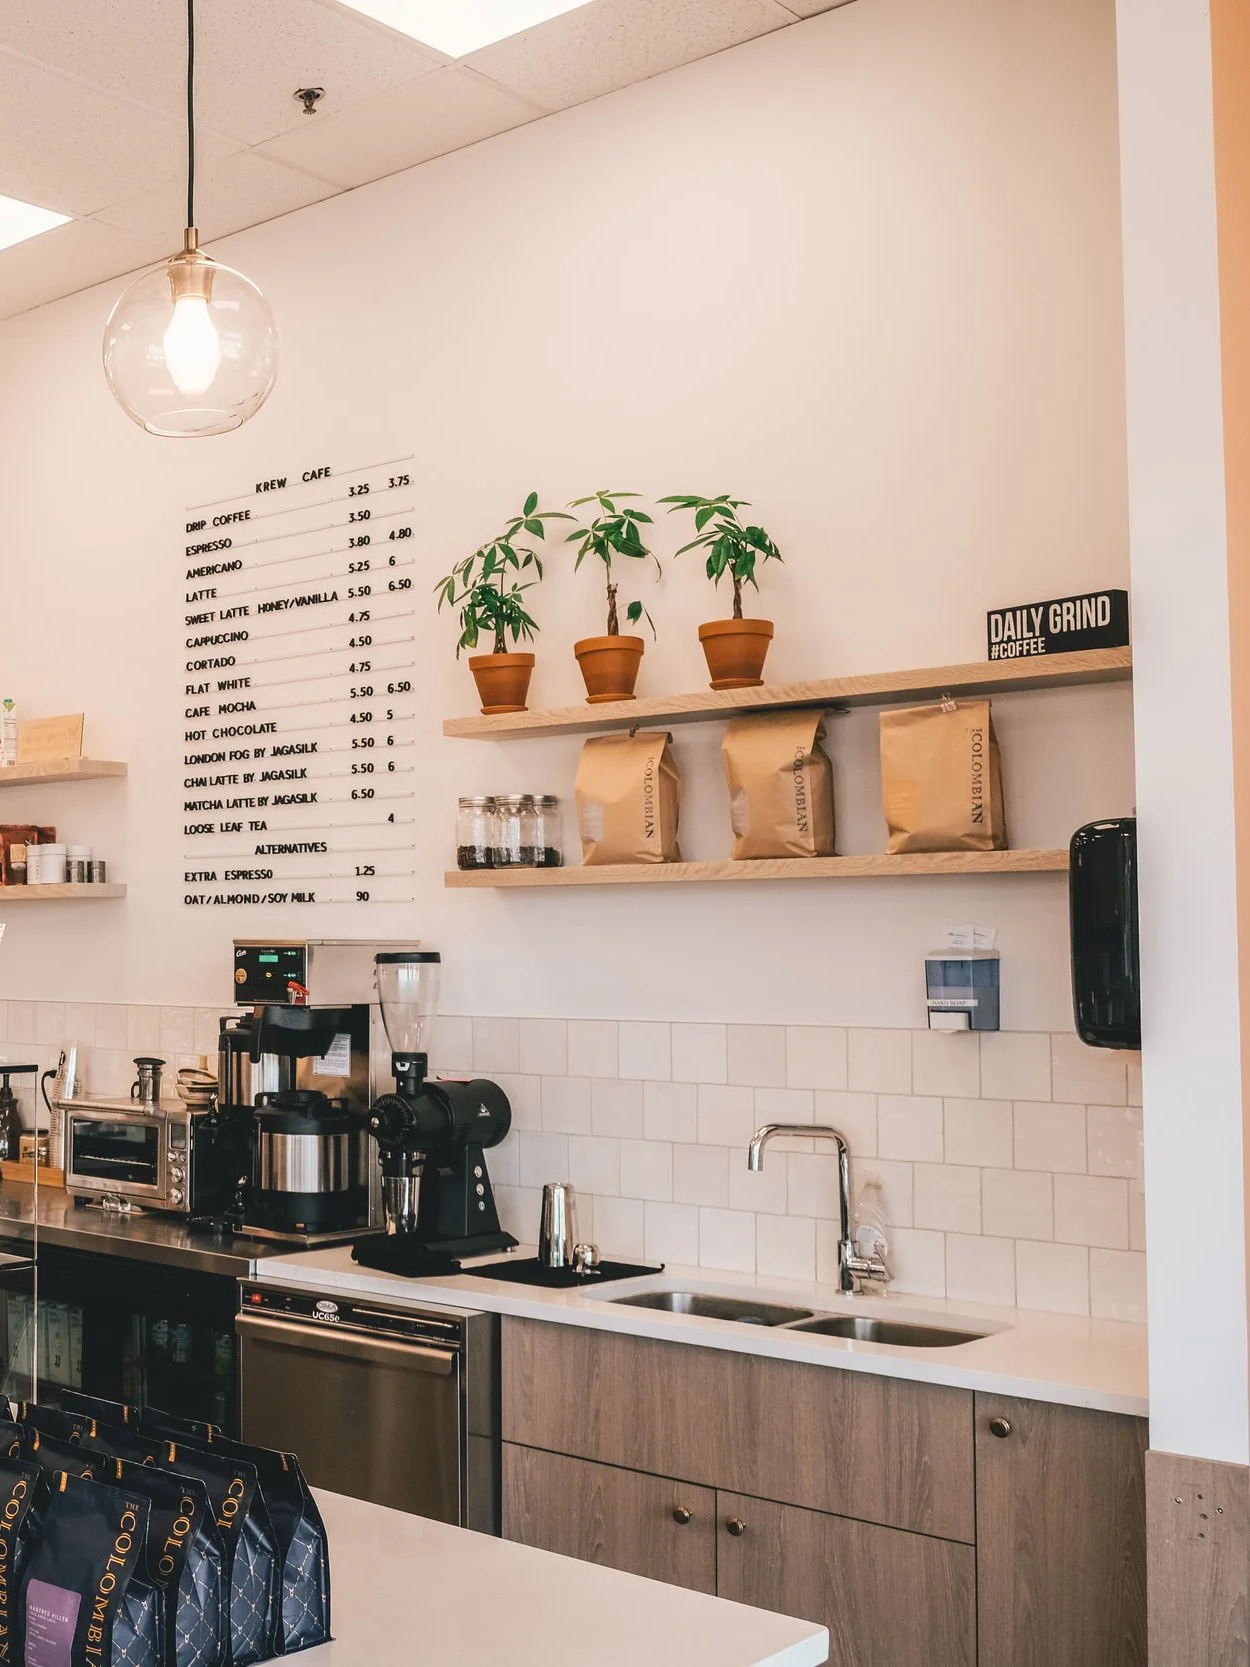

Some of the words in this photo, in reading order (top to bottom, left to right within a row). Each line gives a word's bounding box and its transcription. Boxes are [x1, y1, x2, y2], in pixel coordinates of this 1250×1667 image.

[255, 477, 287, 494] KREW
[302, 466, 331, 483] CAFE
[185, 520, 207, 533] DRIP
[212, 509, 251, 527] COFFEE
[348, 483, 370, 498] 3.25
[388, 474, 410, 489] 3.75
[185, 538, 233, 557] ESPRESSO
[348, 509, 371, 524] 3.50
[185, 559, 243, 580] AMERICANO
[348, 535, 371, 549] 3.80
[388, 527, 412, 541] 4.80
[185, 587, 217, 603] LATTE
[348, 560, 371, 574] 5.25
[388, 555, 396, 567] 6
[184, 611, 216, 626] SWEET
[219, 605, 250, 620] LATTE
[257, 590, 339, 614] HONEY/VANILLA
[347, 585, 372, 599] 5.50
[388, 578, 412, 592] 6.50
[990, 606, 1044, 643] DAILY
[1049, 595, 1111, 635] GRIND
[185, 630, 249, 649] CAPPUCCINO
[348, 610, 371, 623] 4.75
[185, 655, 236, 672] CORTADO
[348, 635, 373, 649] 4.50
[990, 637, 1046, 660] #COFFEE
[185, 682, 211, 695] FLAT
[217, 676, 251, 692] WHITE
[348, 660, 371, 673] 4.75
[184, 706, 211, 719] CAFE
[218, 700, 257, 715] MOCHA
[350, 685, 374, 699] 5.50
[387, 680, 411, 694] 6.50
[184, 729, 207, 742] HOT
[212, 722, 278, 739] CHOCOLATE
[349, 711, 373, 724] 4.50
[386, 709, 394, 720] 5
[184, 751, 226, 766] LONDON
[229, 749, 250, 761] FOG
[253, 747, 267, 759] BY
[270, 741, 318, 757] JAGASILK
[351, 737, 375, 749] 5.50
[386, 735, 395, 746] 6
[183, 776, 208, 789] CHAI
[209, 774, 239, 787] LATTE
[242, 772, 255, 784] BY
[258, 767, 308, 783] JAGASILK
[351, 762, 375, 775] 5.50
[387, 761, 395, 772] 6
[793, 750, 808, 832] COLOMBIAN
[972, 733, 983, 824] COLOMBIAN
[183, 799, 224, 812] MATCHA
[226, 797, 256, 809] LATTE
[257, 795, 270, 807] BY
[271, 792, 318, 806] JAGASILK
[351, 788, 375, 800] 6.50
[644, 760, 654, 839] COLOMBIAN
[183, 823, 215, 836] LOOSE
[220, 821, 244, 833] LEAF
[247, 820, 268, 832] TEA
[387, 812, 395, 824] 4
[254, 841, 328, 856] ALTERNATIVES
[184, 871, 218, 883] EXTRA
[224, 868, 274, 881] ESPRESSO
[355, 865, 376, 877] 1.25
[290, 892, 316, 903] MILK
[355, 890, 370, 902] 90
[124, 1501, 141, 1512] THE
